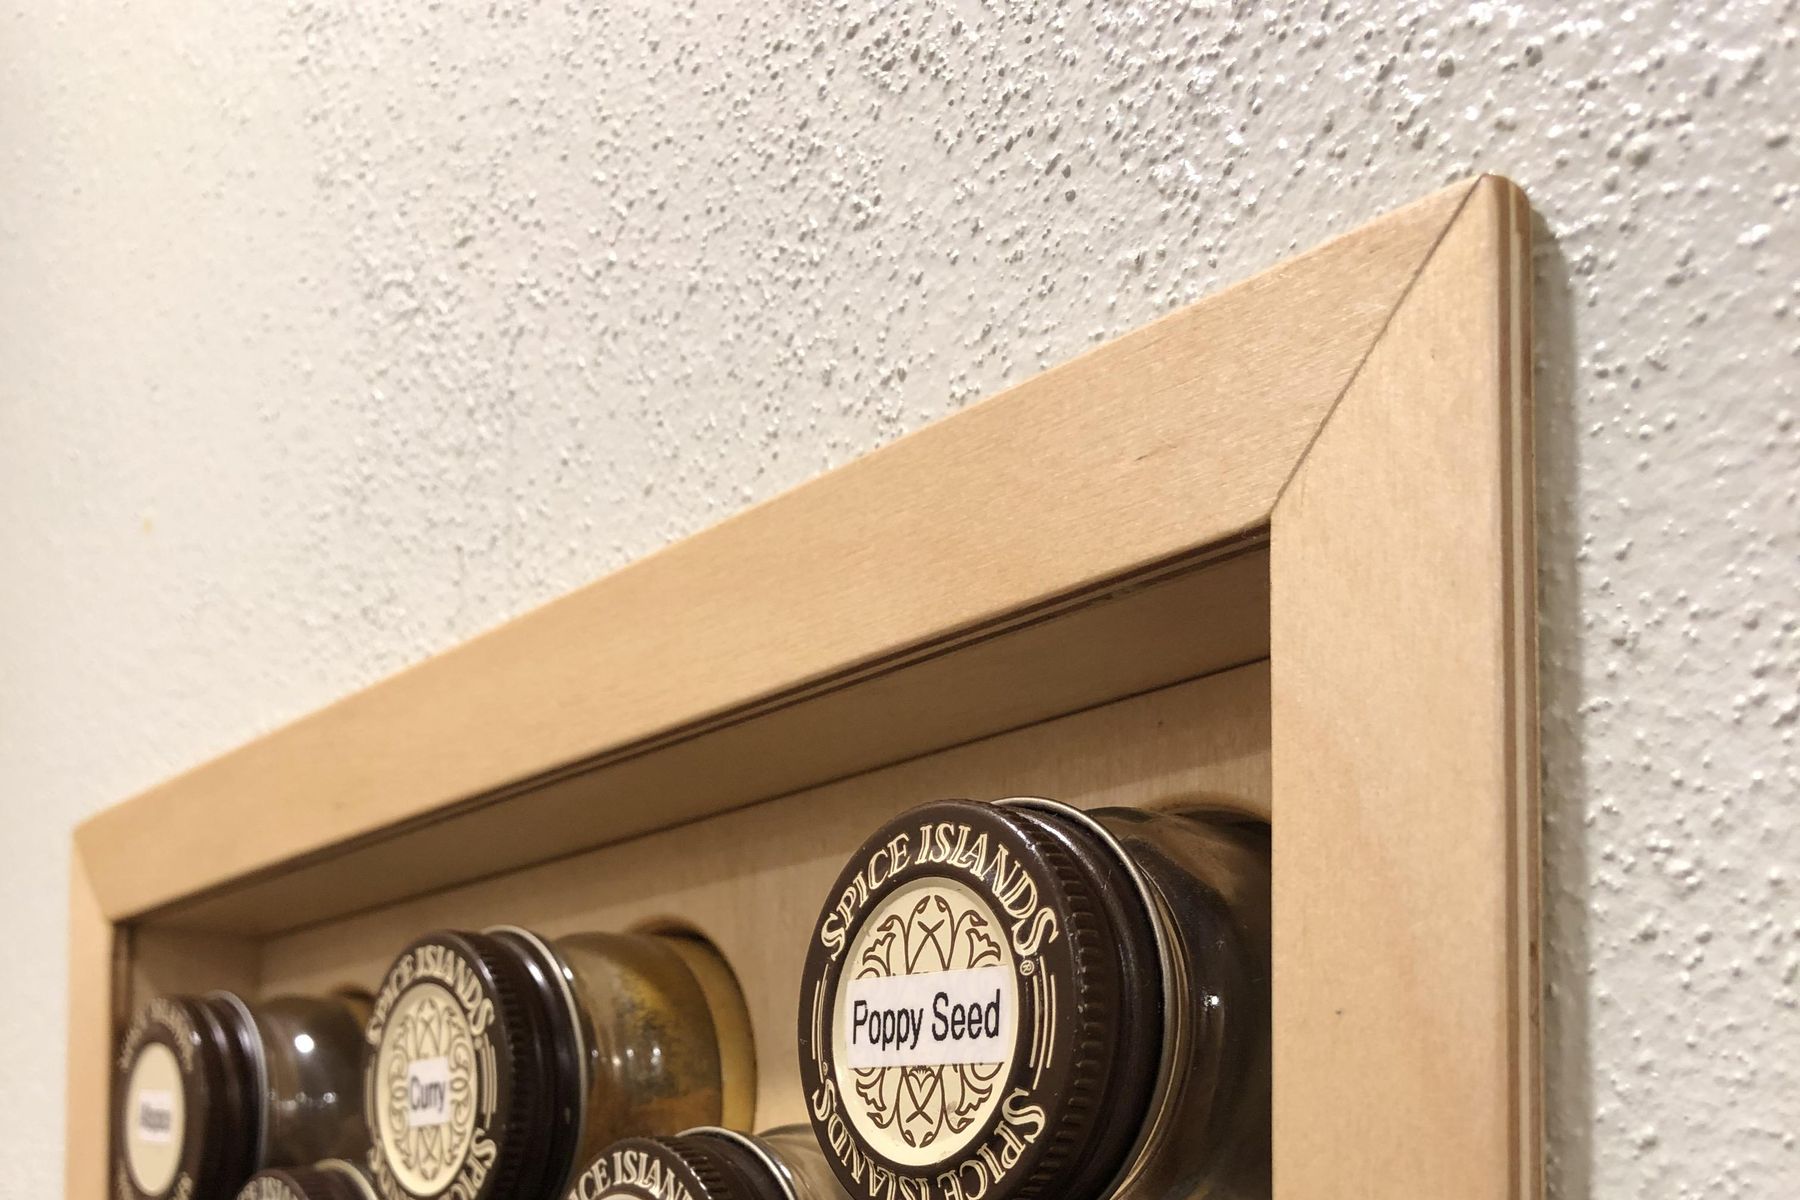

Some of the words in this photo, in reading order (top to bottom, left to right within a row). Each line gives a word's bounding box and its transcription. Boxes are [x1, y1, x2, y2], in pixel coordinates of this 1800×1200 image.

[820, 832, 911, 961] SPICE
[852, 998, 924, 1050] Poppy
[931, 989, 1001, 1043] Seed
[410, 1076, 447, 1113] Curry
